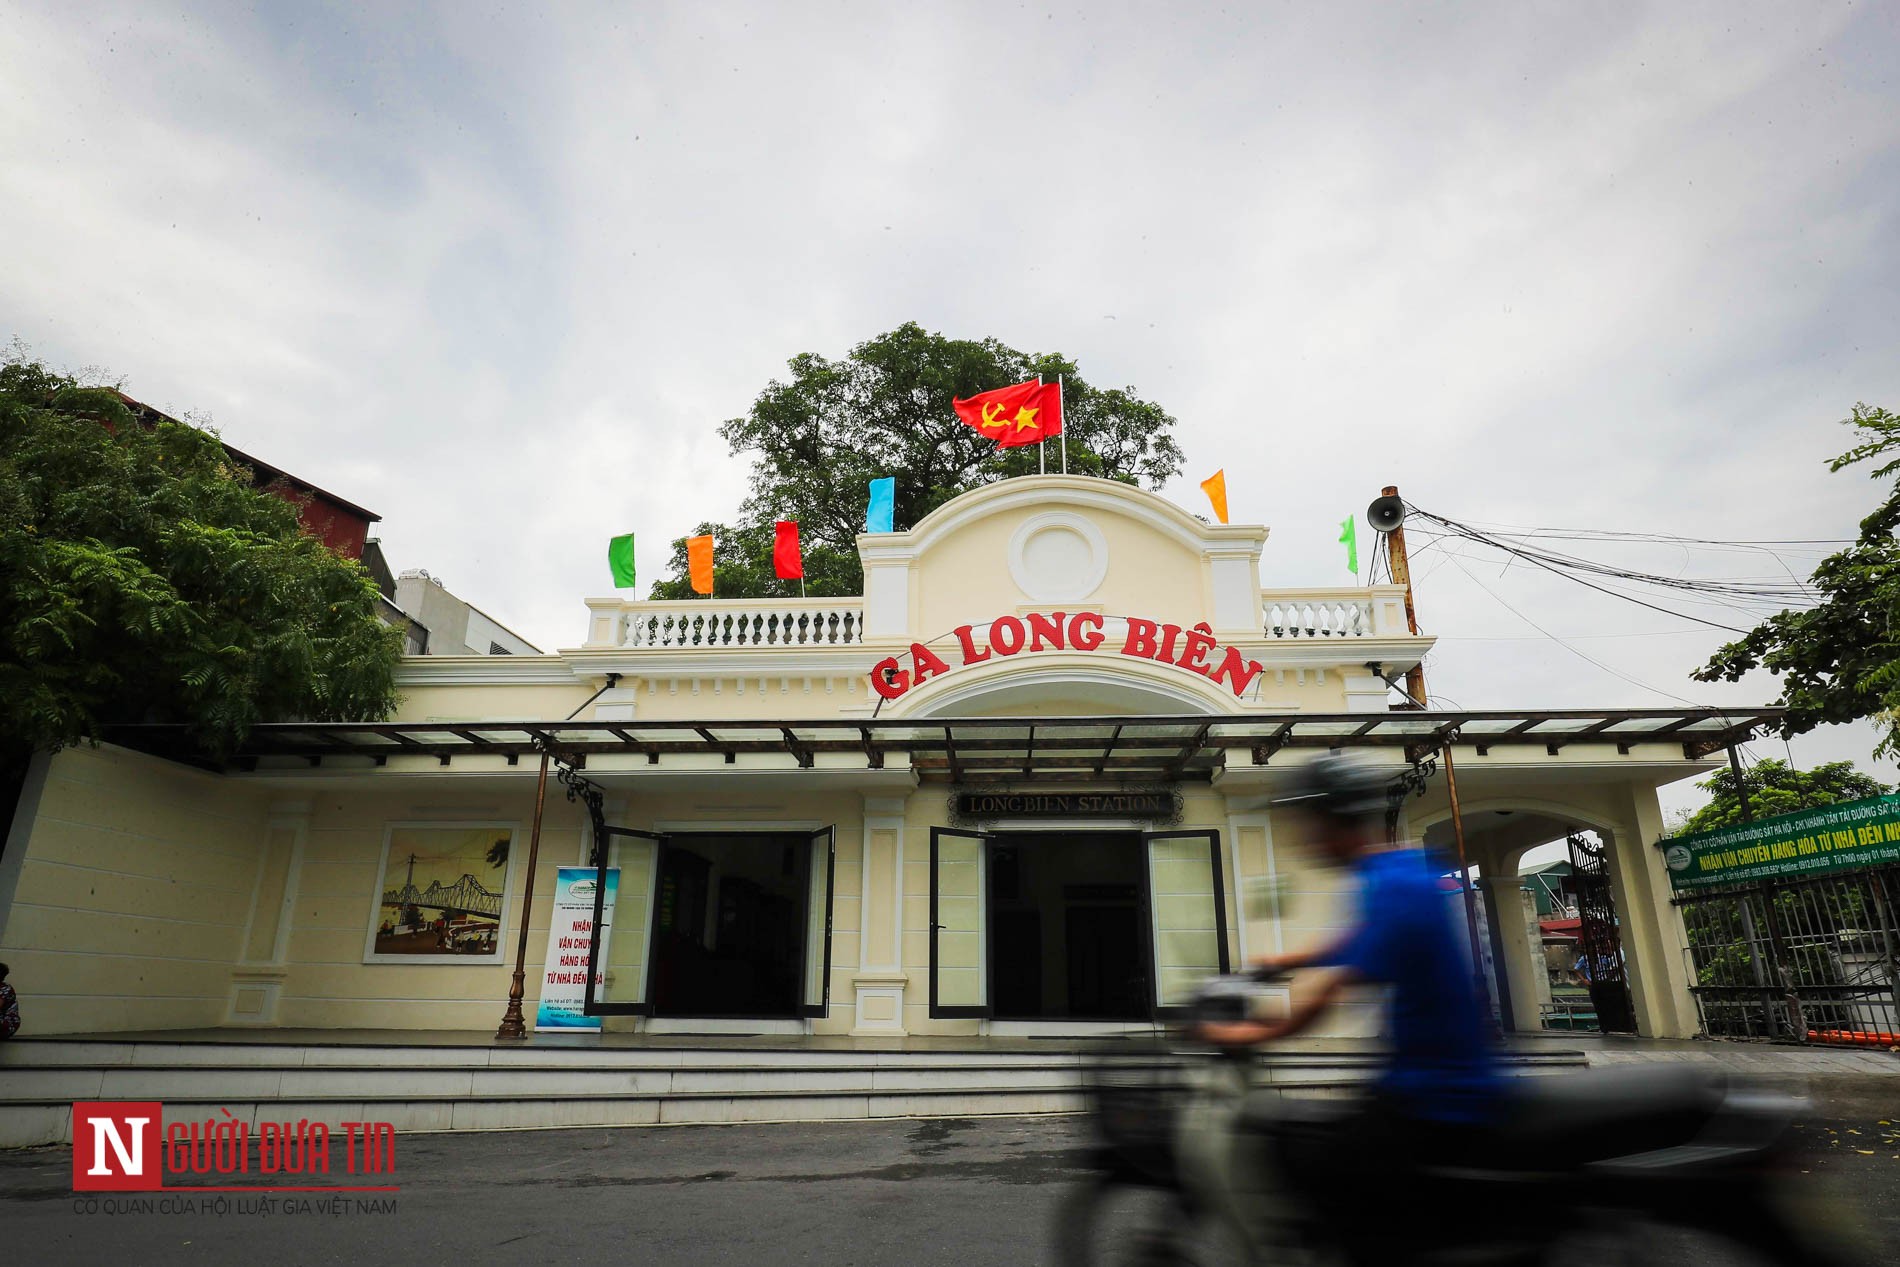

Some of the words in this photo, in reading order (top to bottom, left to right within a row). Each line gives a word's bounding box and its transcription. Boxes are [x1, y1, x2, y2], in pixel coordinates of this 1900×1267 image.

[870, 641, 950, 700] GA
[953, 611, 1106, 667] LONG
[1121, 617, 1264, 698] BIÊN
[1078, 796, 1160, 812] STATION
[1699, 852, 1723, 873] NHẬN
[1722, 848, 1738, 871] VẬN
[1738, 840, 1771, 865] CHUYỂN
[1771, 839, 1798, 860] HÀNG
[1797, 833, 1819, 856] HÓA
[1817, 829, 1832, 852] TỪ
[1831, 825, 1858, 850] NHÀ
[1858, 820, 1884, 846] ĐẾN
[572, 919, 592, 934] NHẬN
[559, 935, 573, 951] VẬN
[560, 953, 579, 967] HÀNG
[547, 970, 557, 984] TỪ
[557, 970, 571, 984] NHÀ
[572, 970, 587, 985] ĐẾN
